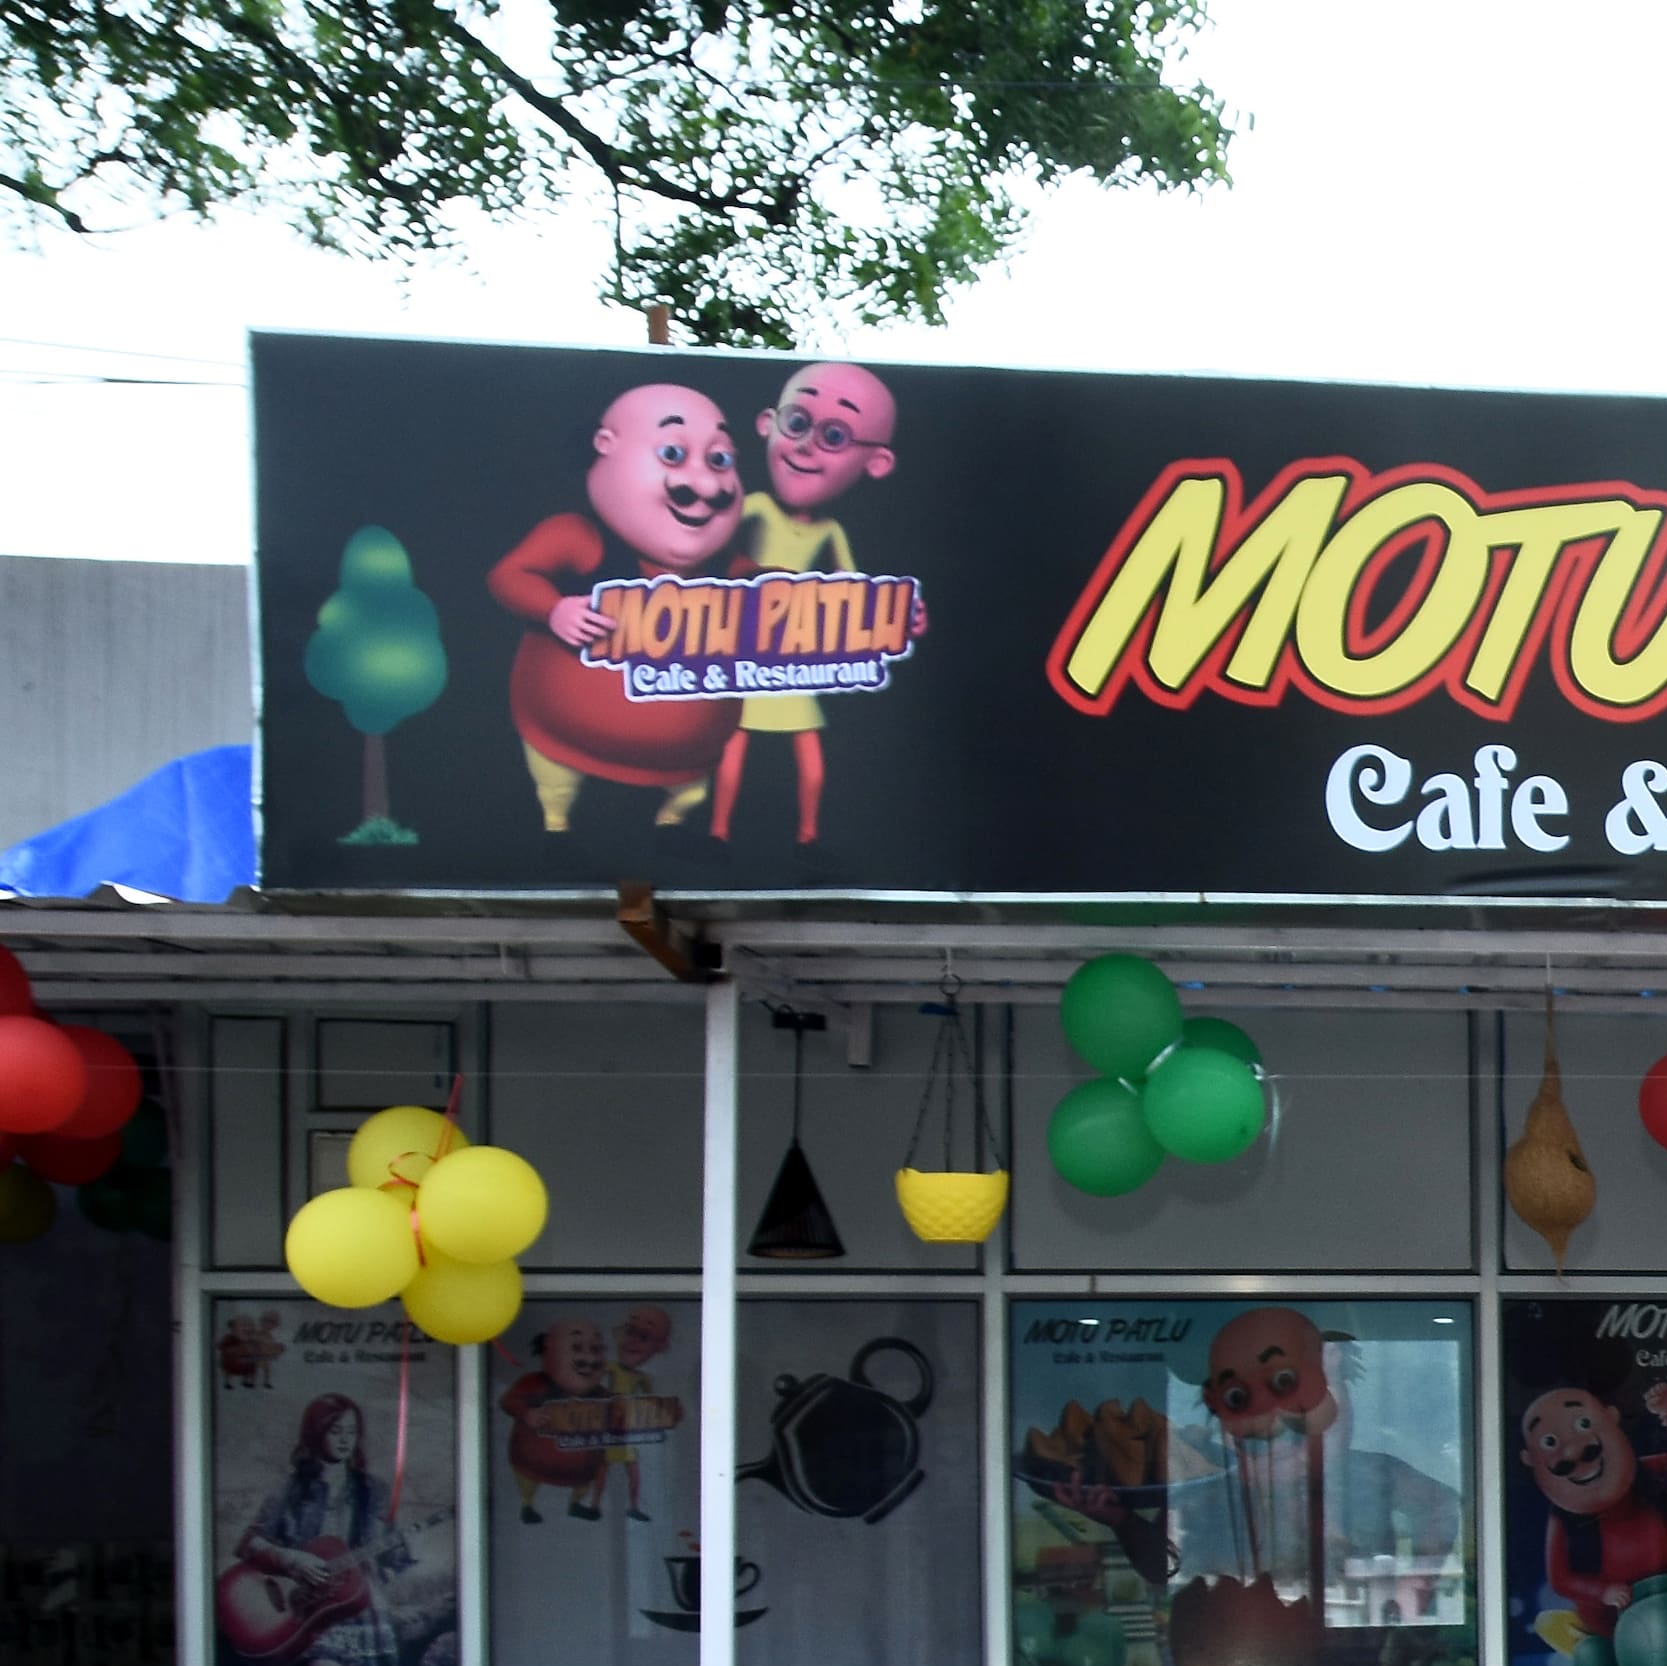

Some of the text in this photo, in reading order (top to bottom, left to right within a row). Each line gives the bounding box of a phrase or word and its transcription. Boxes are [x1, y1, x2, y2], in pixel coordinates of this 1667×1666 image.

[590, 579, 910, 659] MOTU PATLU
[633, 659, 879, 692] Cafe & Restaurant
[1324, 743, 1570, 854] Cafe
[1023, 1317, 1192, 1344] MOTU PATLU
